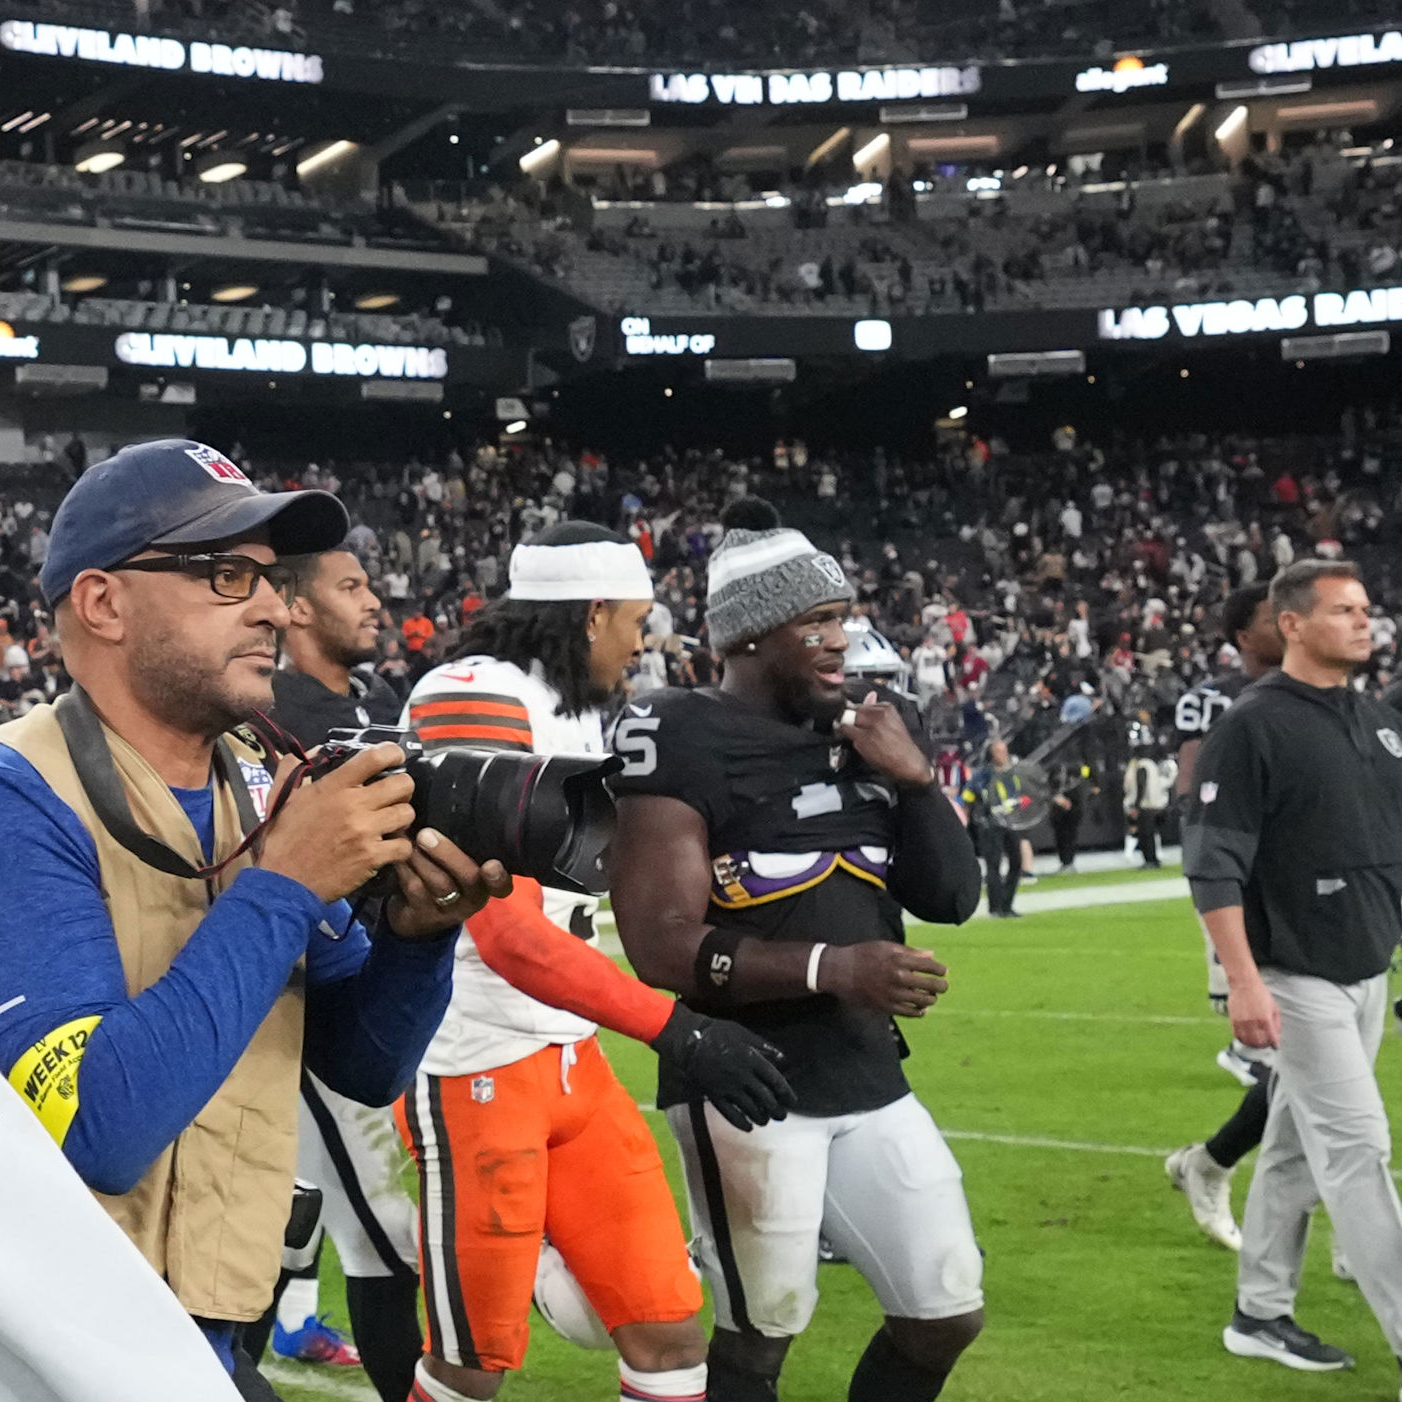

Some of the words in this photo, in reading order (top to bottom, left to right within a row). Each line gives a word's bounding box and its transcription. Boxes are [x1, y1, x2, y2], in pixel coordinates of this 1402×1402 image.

[190, 42, 324, 84] BROWNS
[649, 73, 709, 103] LAS
[837, 66, 982, 100] RAIDERS
[621, 317, 650, 336] ON
[1098, 305, 1169, 340] LAS
[1171, 295, 1308, 337] VEGAS
[115, 333, 306, 373] CLEVELAND
[311, 342, 447, 379] BROWNS
[626, 334, 688, 354] BEHALF
[689, 334, 715, 354] OF
[24, 1040, 70, 1103] WEEK
[68, 1029, 89, 1051] 12
